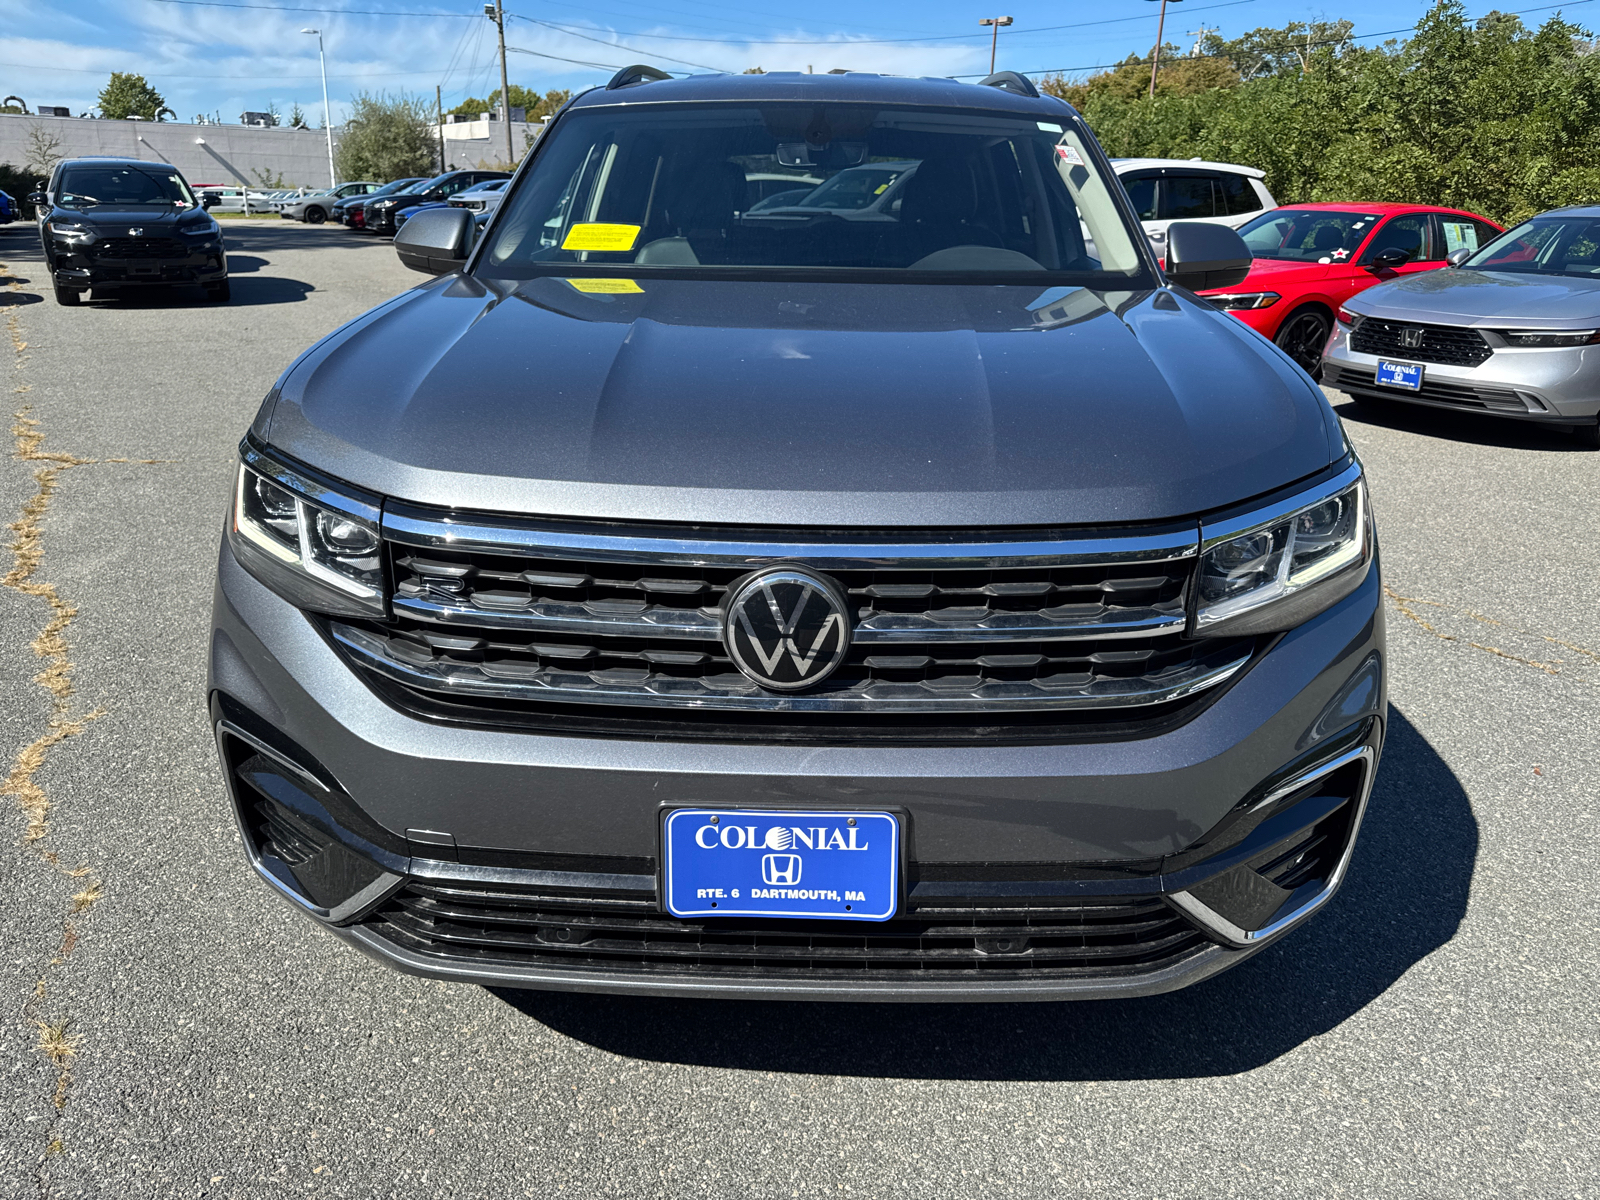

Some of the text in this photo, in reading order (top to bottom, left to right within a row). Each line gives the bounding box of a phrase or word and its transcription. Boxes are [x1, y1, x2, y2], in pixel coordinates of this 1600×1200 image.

[695, 824, 869, 851] COLONIAL
[697, 888, 866, 902] RTE. 6 DARTMOUTH, MA
